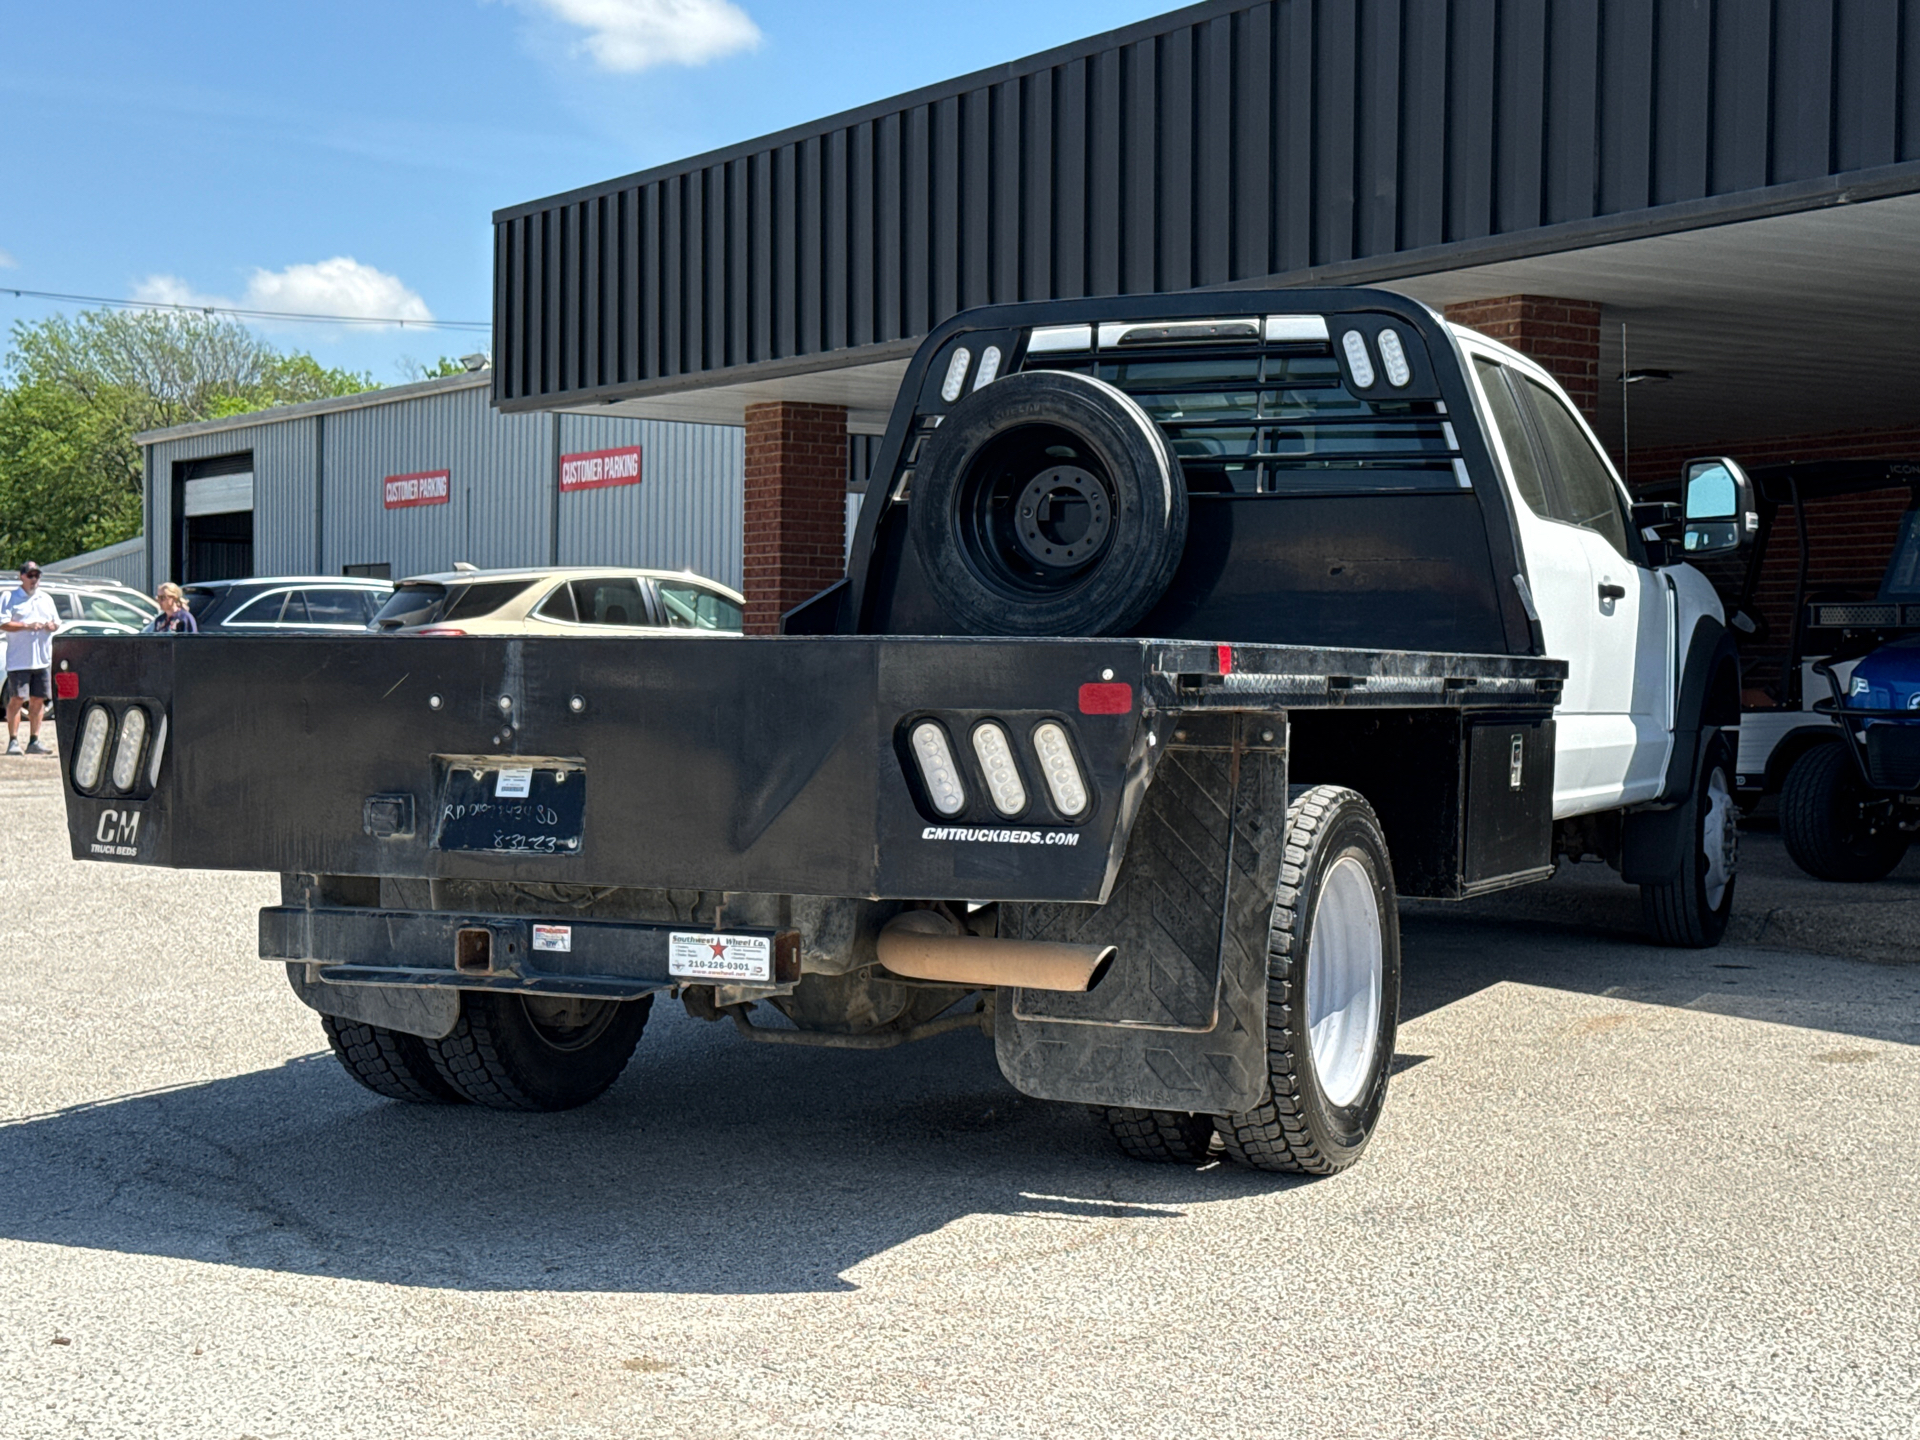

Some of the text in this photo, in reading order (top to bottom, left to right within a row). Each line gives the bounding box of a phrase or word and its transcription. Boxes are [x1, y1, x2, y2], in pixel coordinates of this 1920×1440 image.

[562, 453, 638, 484] CUSTOMER PARKING
[1889, 464, 1920, 474] ICON
[386, 476, 447, 502] CUSTOMER PARKING
[96, 809, 140, 845] CM
[921, 827, 1079, 846] CMTRUCKBEDS.COM
[91, 844, 137, 856] TRUCK BEDS
[672, 935, 714, 944] Southwest
[725, 938, 751, 946] Wheel
[688, 960, 750, 971] 210-226-0301
